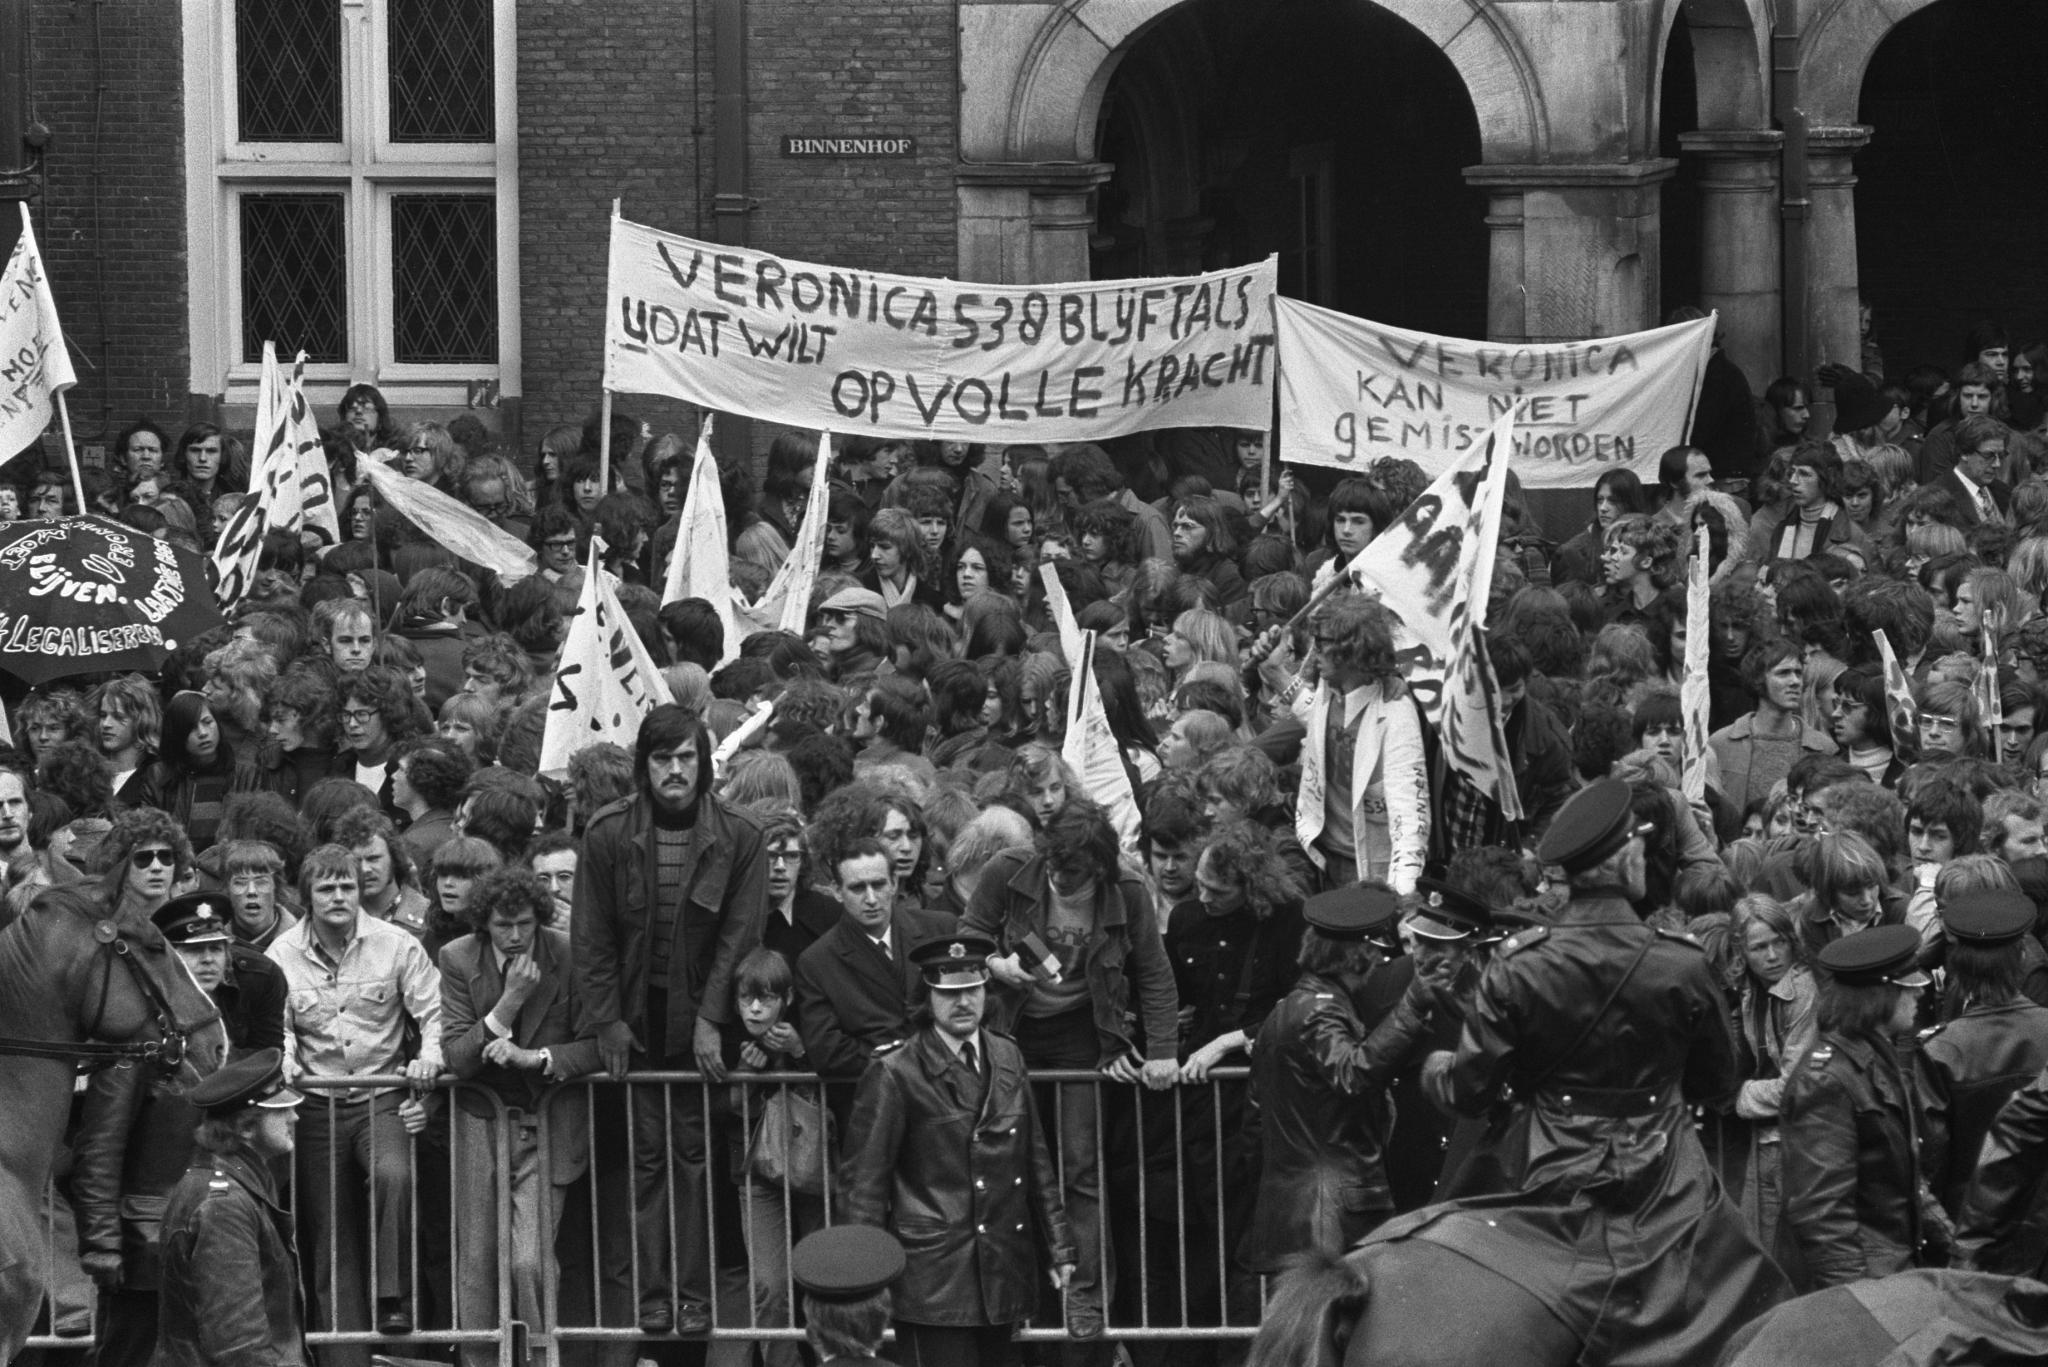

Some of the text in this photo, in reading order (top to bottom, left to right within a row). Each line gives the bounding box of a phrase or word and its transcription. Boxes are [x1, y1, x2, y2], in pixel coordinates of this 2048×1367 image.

[789, 139, 912, 154] BINNENHOF
[952, 291, 1049, 351] 538
[831, 334, 1275, 427] OP VOLLE KRACHT
[1356, 369, 1444, 412] KAN
